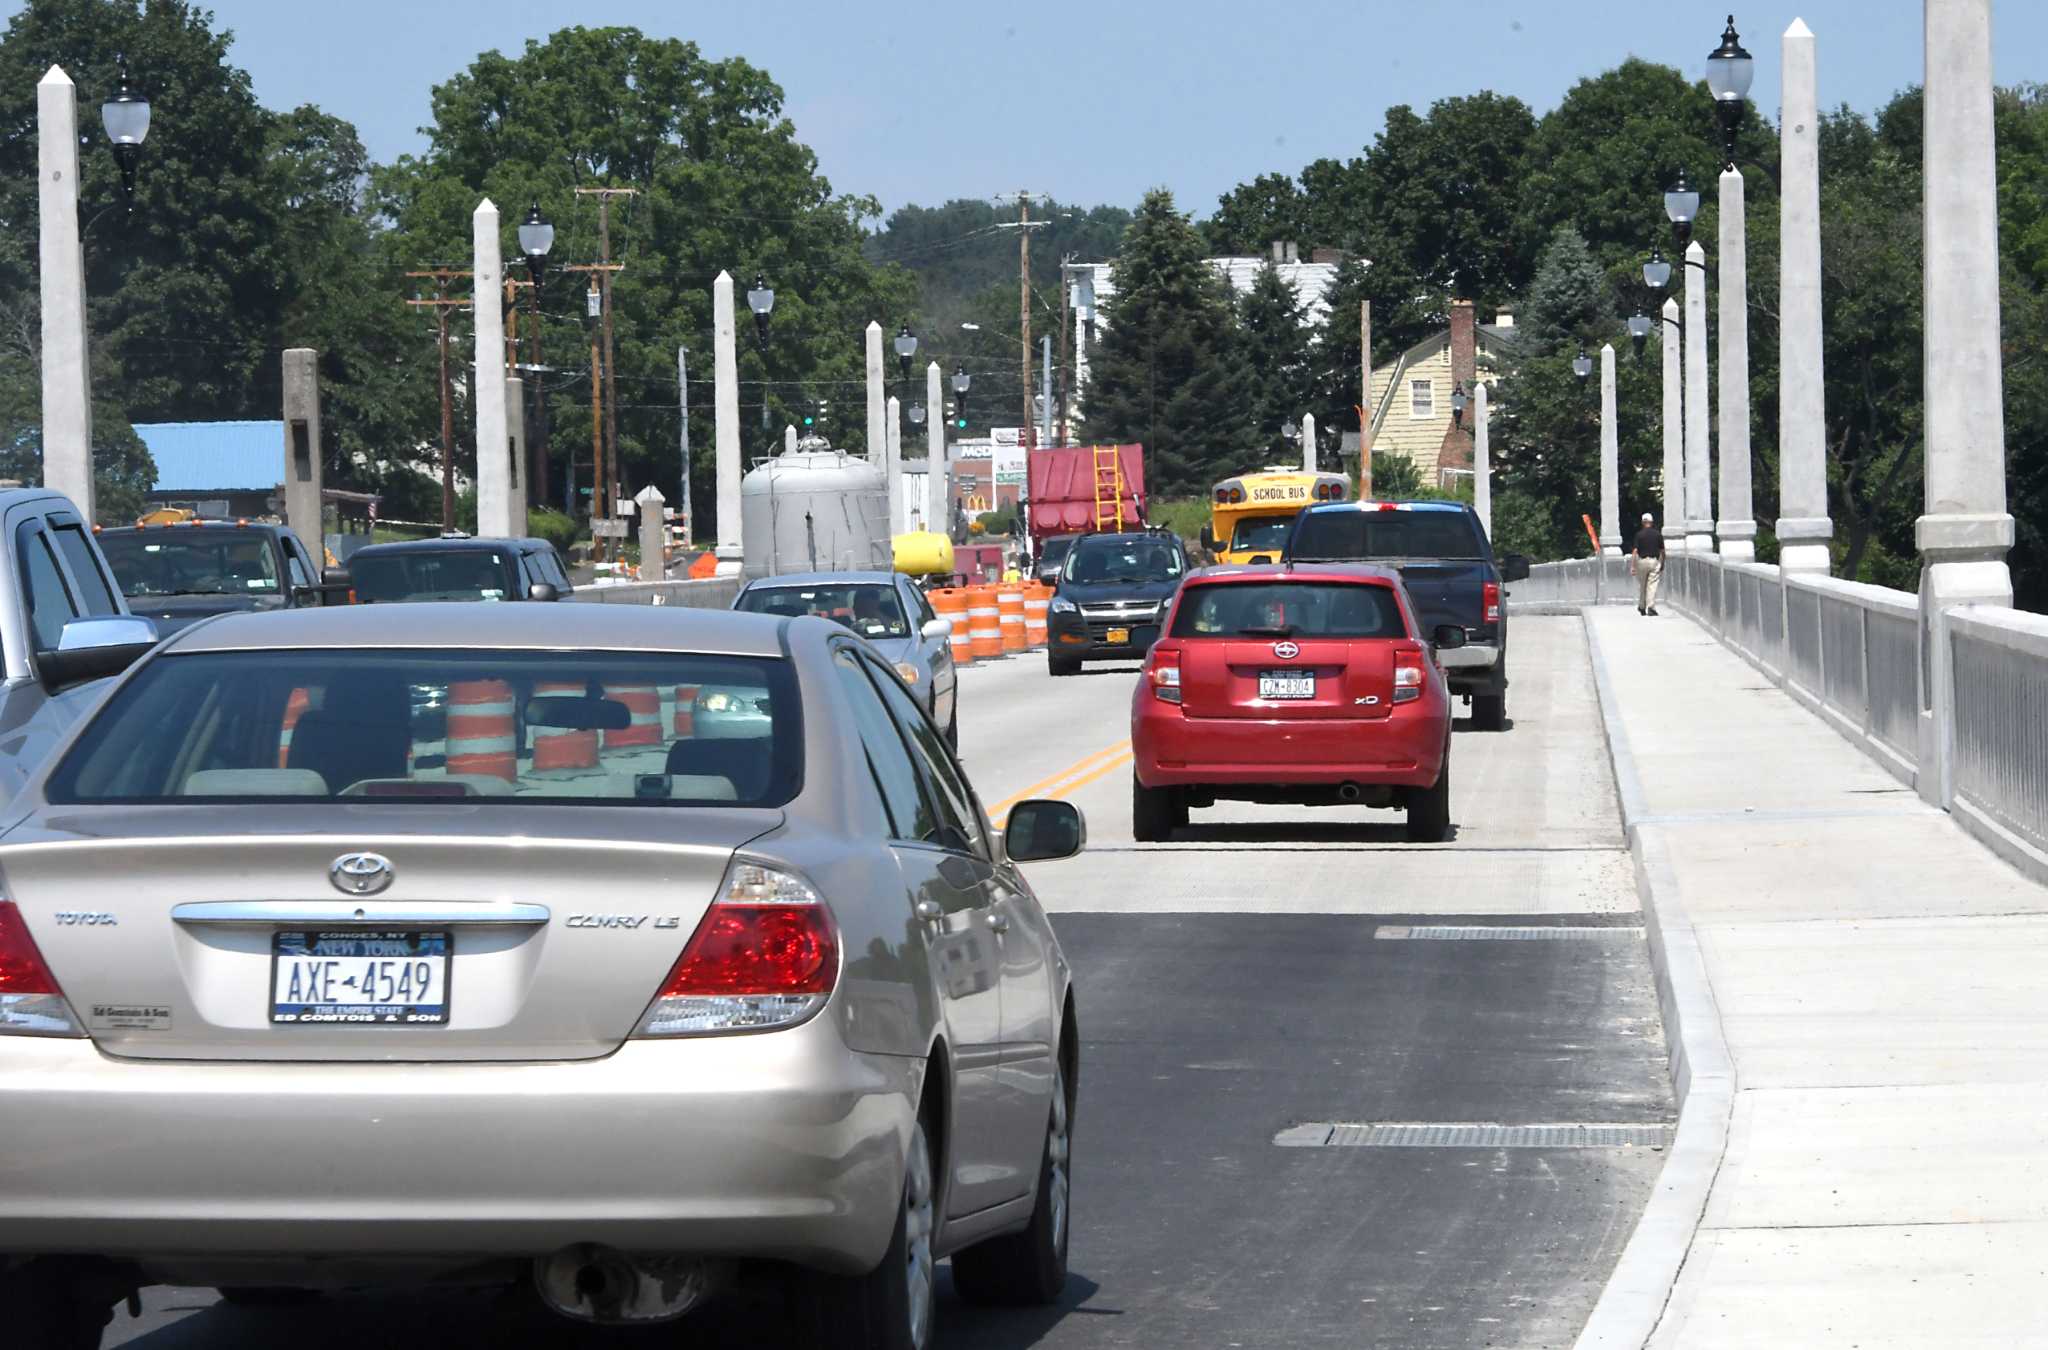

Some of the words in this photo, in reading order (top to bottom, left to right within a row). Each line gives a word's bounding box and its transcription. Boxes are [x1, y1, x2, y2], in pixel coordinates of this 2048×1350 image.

[1254, 487, 1286, 500] SCHOOL
[1288, 487, 1305, 498] BUS
[55, 912, 118, 926] TOYOTA
[566, 914, 648, 929] CAMRY
[653, 915, 680, 929] LE
[317, 940, 355, 956] NEW
[364, 940, 409, 956] YORK
[315, 1006, 334, 1015] THE
[336, 1006, 372, 1015] EMPIRE
[375, 1006, 404, 1015] STATE
[273, 1014, 297, 1022] ED
[300, 1014, 377, 1022] COMTOIS
[407, 1014, 442, 1022] SON
